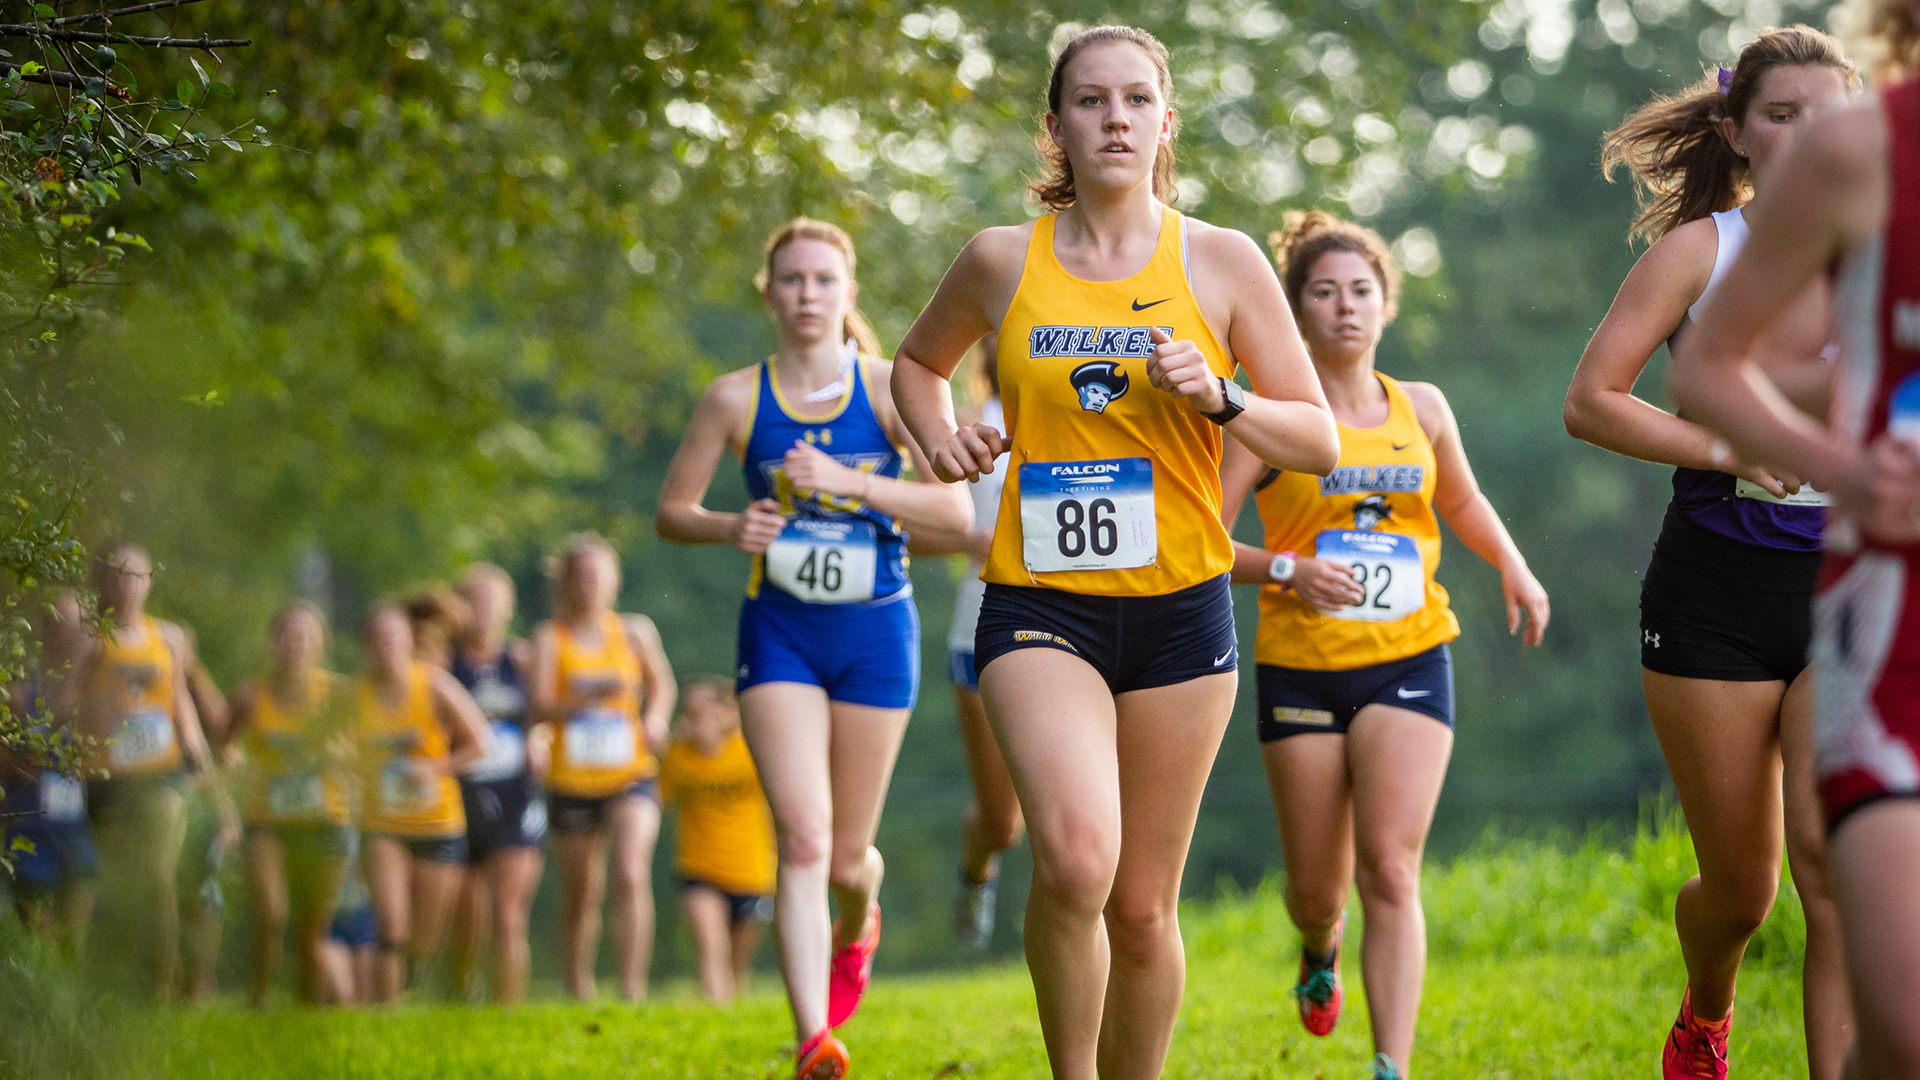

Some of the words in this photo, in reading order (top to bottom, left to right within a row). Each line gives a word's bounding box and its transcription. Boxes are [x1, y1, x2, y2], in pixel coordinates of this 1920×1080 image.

[1029, 325, 1174, 358] WILKE
[1051, 463, 1120, 476] FALCON
[1319, 465, 1424, 496] WILKES
[1056, 498, 1118, 558] 86
[796, 548, 843, 592] 46
